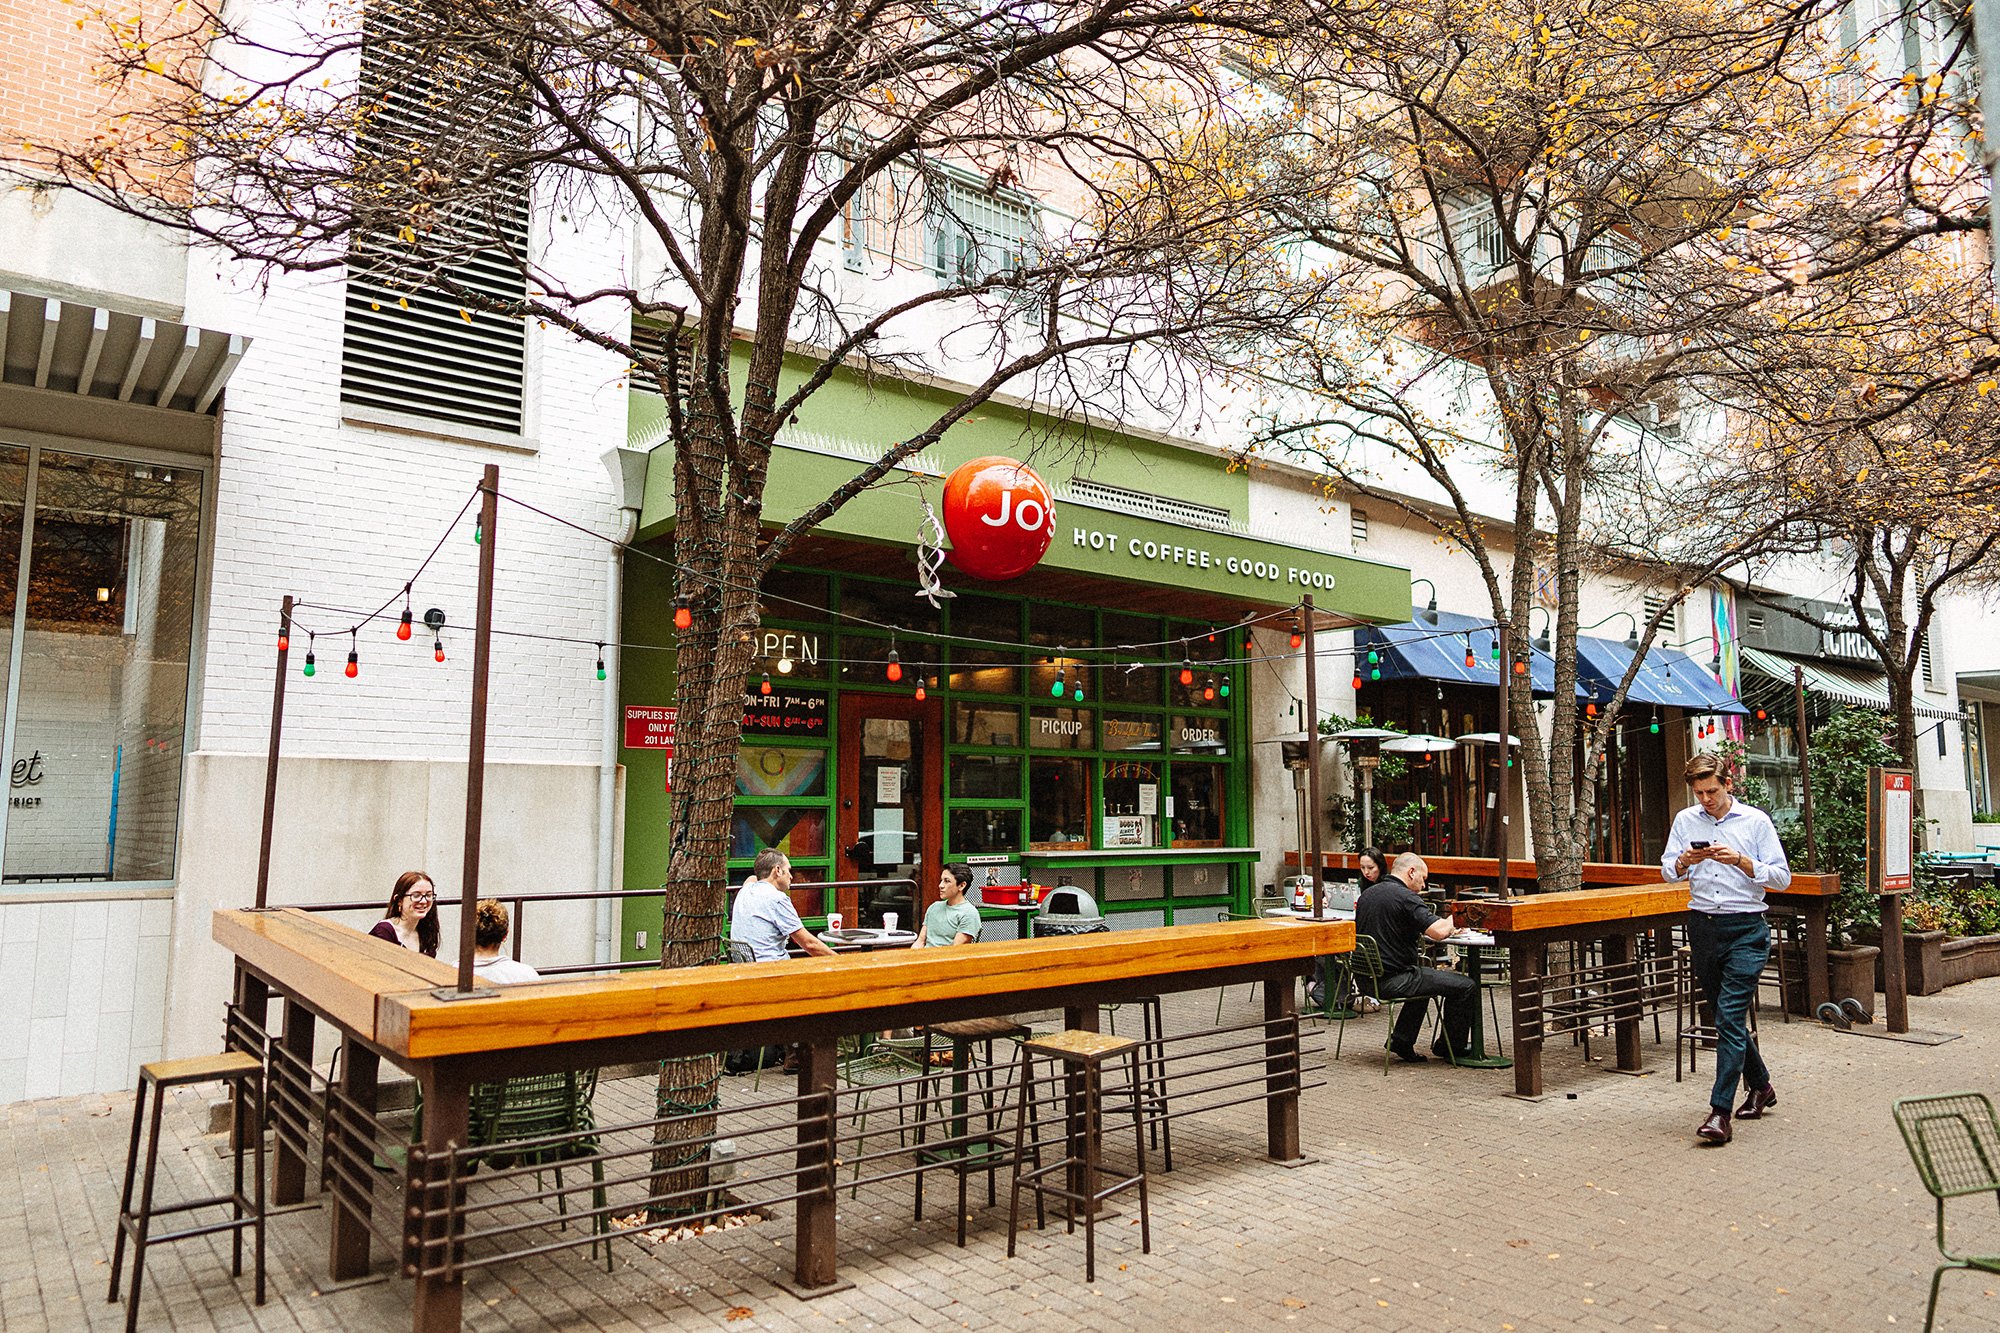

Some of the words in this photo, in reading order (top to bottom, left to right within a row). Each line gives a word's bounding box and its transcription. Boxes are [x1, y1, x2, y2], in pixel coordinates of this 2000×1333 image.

[1073, 527, 1118, 552] HOT
[1128, 538, 1210, 568] COFFEE
[1226, 556, 1280, 580] GOOD
[1287, 567, 1336, 590] FOOD
[742, 695, 780, 708] ON-FRI
[627, 709, 663, 720] SUPPLIES
[742, 713, 781, 727] AT-SUN
[648, 723, 667, 732] ONLY
[1041, 719, 1083, 736] PICKUP
[644, 735, 658, 744] 201
[660, 735, 674, 745] LAV
[1181, 727, 1215, 742] ORDER
